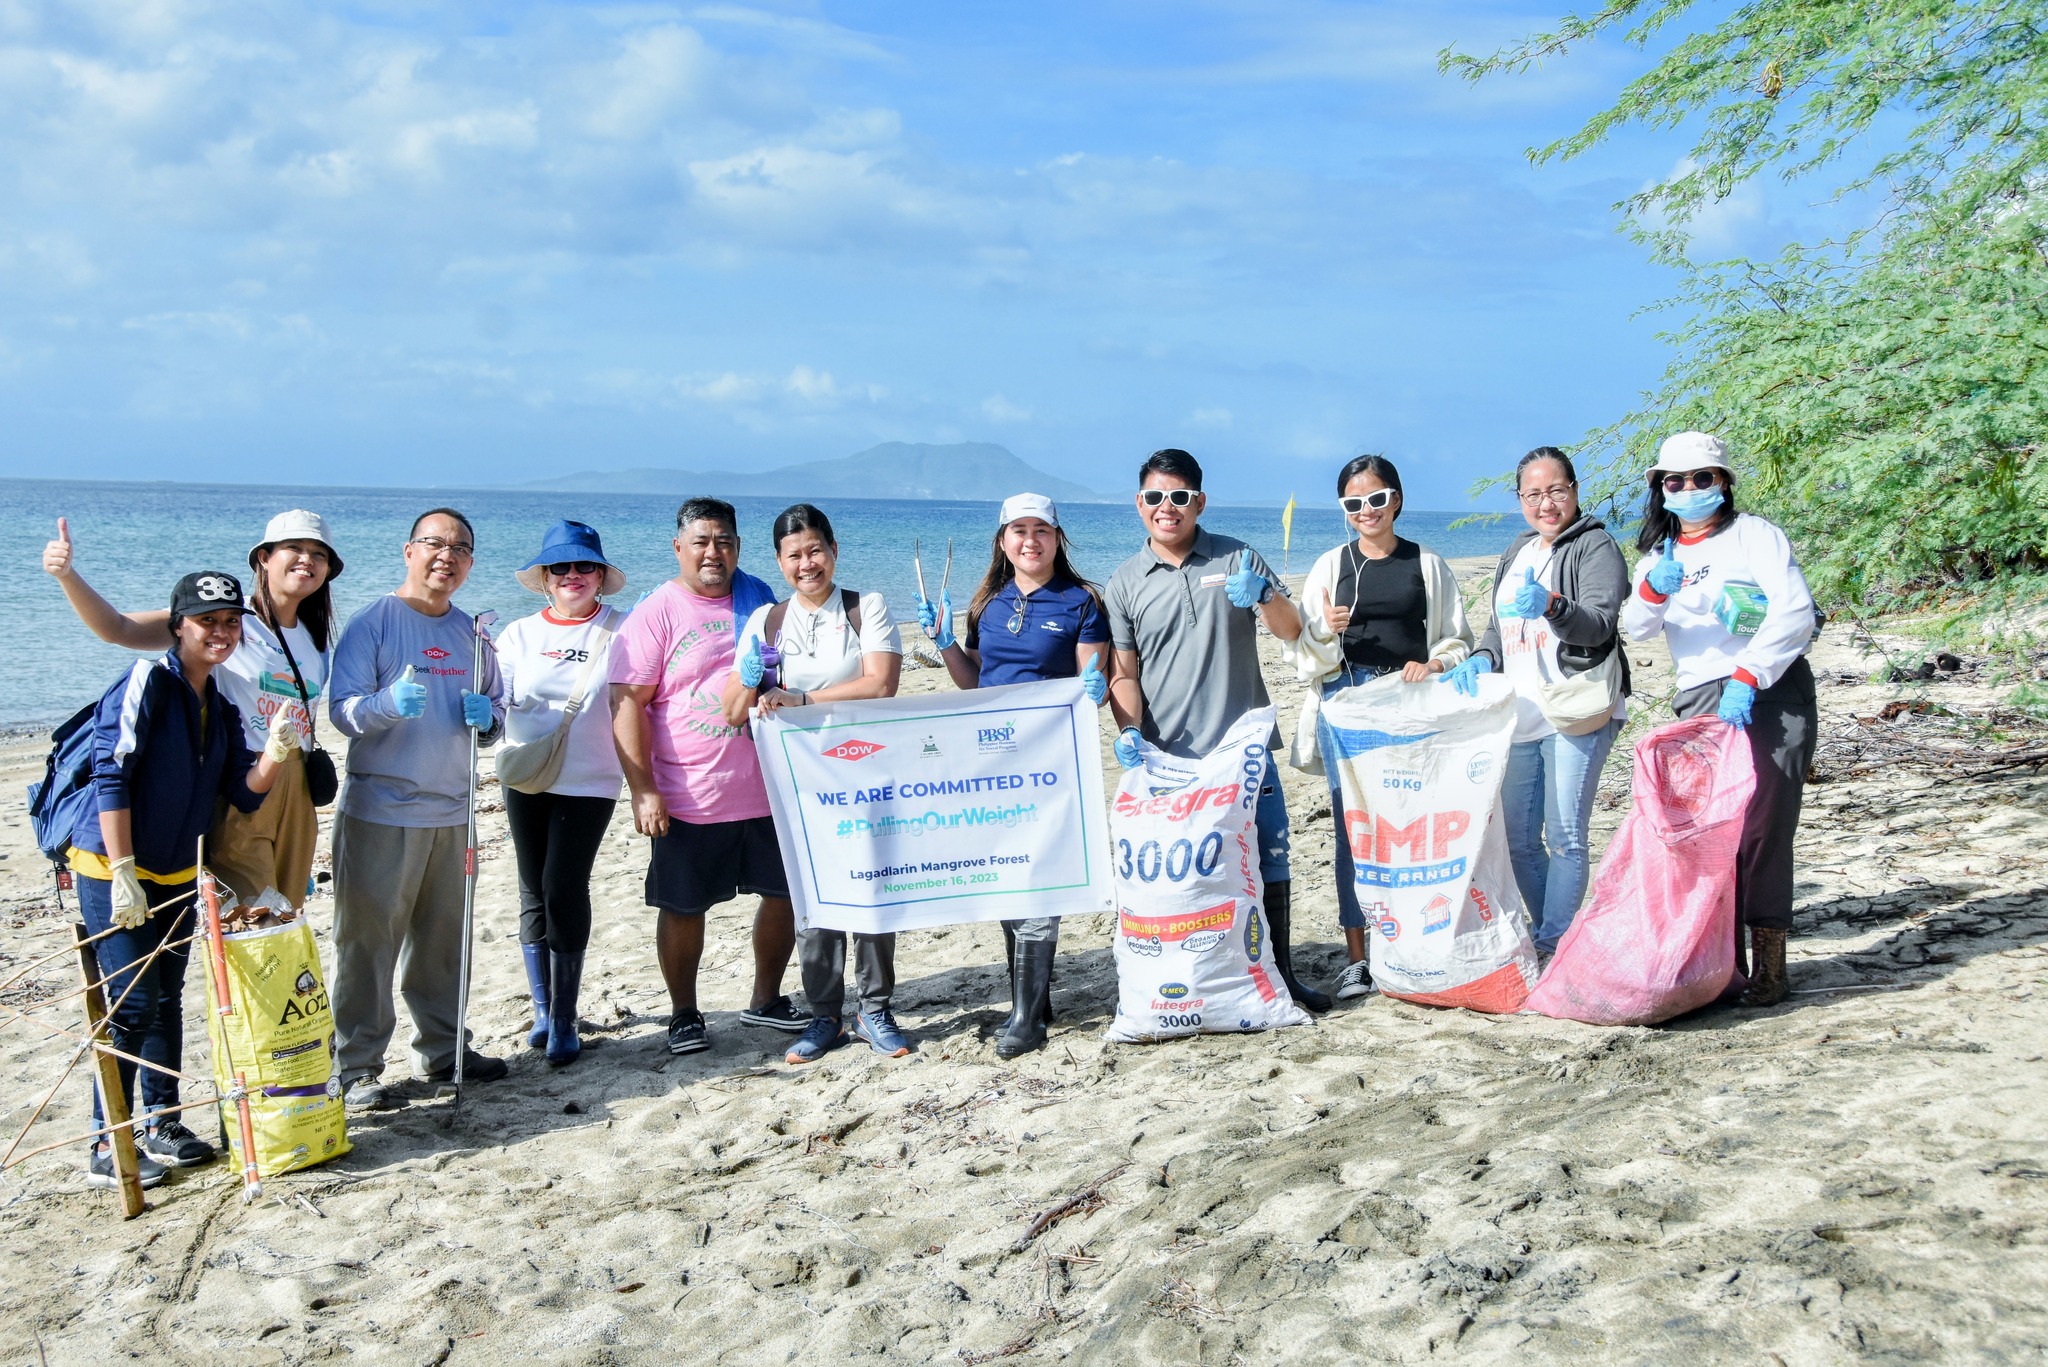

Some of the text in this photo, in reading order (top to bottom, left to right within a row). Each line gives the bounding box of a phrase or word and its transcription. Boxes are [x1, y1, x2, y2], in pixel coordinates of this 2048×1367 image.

[1737, 624, 1759, 633] Touc
[977, 727, 1015, 743] PBSP
[836, 744, 873, 758] DOW
[816, 771, 1058, 806] WE ARE COMMITTED TO
[1383, 778, 1422, 792] 50 Kg
[1113, 783, 1241, 822] egra
[837, 803, 1039, 839] #PullingOurWeight
[1344, 809, 1471, 864] GMP
[1119, 831, 1223, 883] 3000
[850, 853, 1030, 882] Lagadlarin Mangrove Forest
[1355, 863, 1461, 883] REE RANGE
[884, 872, 999, 893] November 16, 2023
[1469, 887, 1493, 922] GMP
[1123, 917, 1161, 934] IMMUNO
[1169, 911, 1232, 934] BOOSTERS
[1128, 941, 1162, 952] PROBIOTICS
[1189, 933, 1218, 944] ORGANIC
[1189, 939, 1218, 949] SELENIUM
[255, 952, 277, 978] Naturally
[1151, 998, 1204, 1012] Integra
[274, 1029, 290, 1037] Pure
[291, 1020, 311, 1033] Natural
[1158, 1013, 1202, 1029] 3000
[288, 1056, 300, 1064] Food
[274, 1066, 291, 1074] Safe
